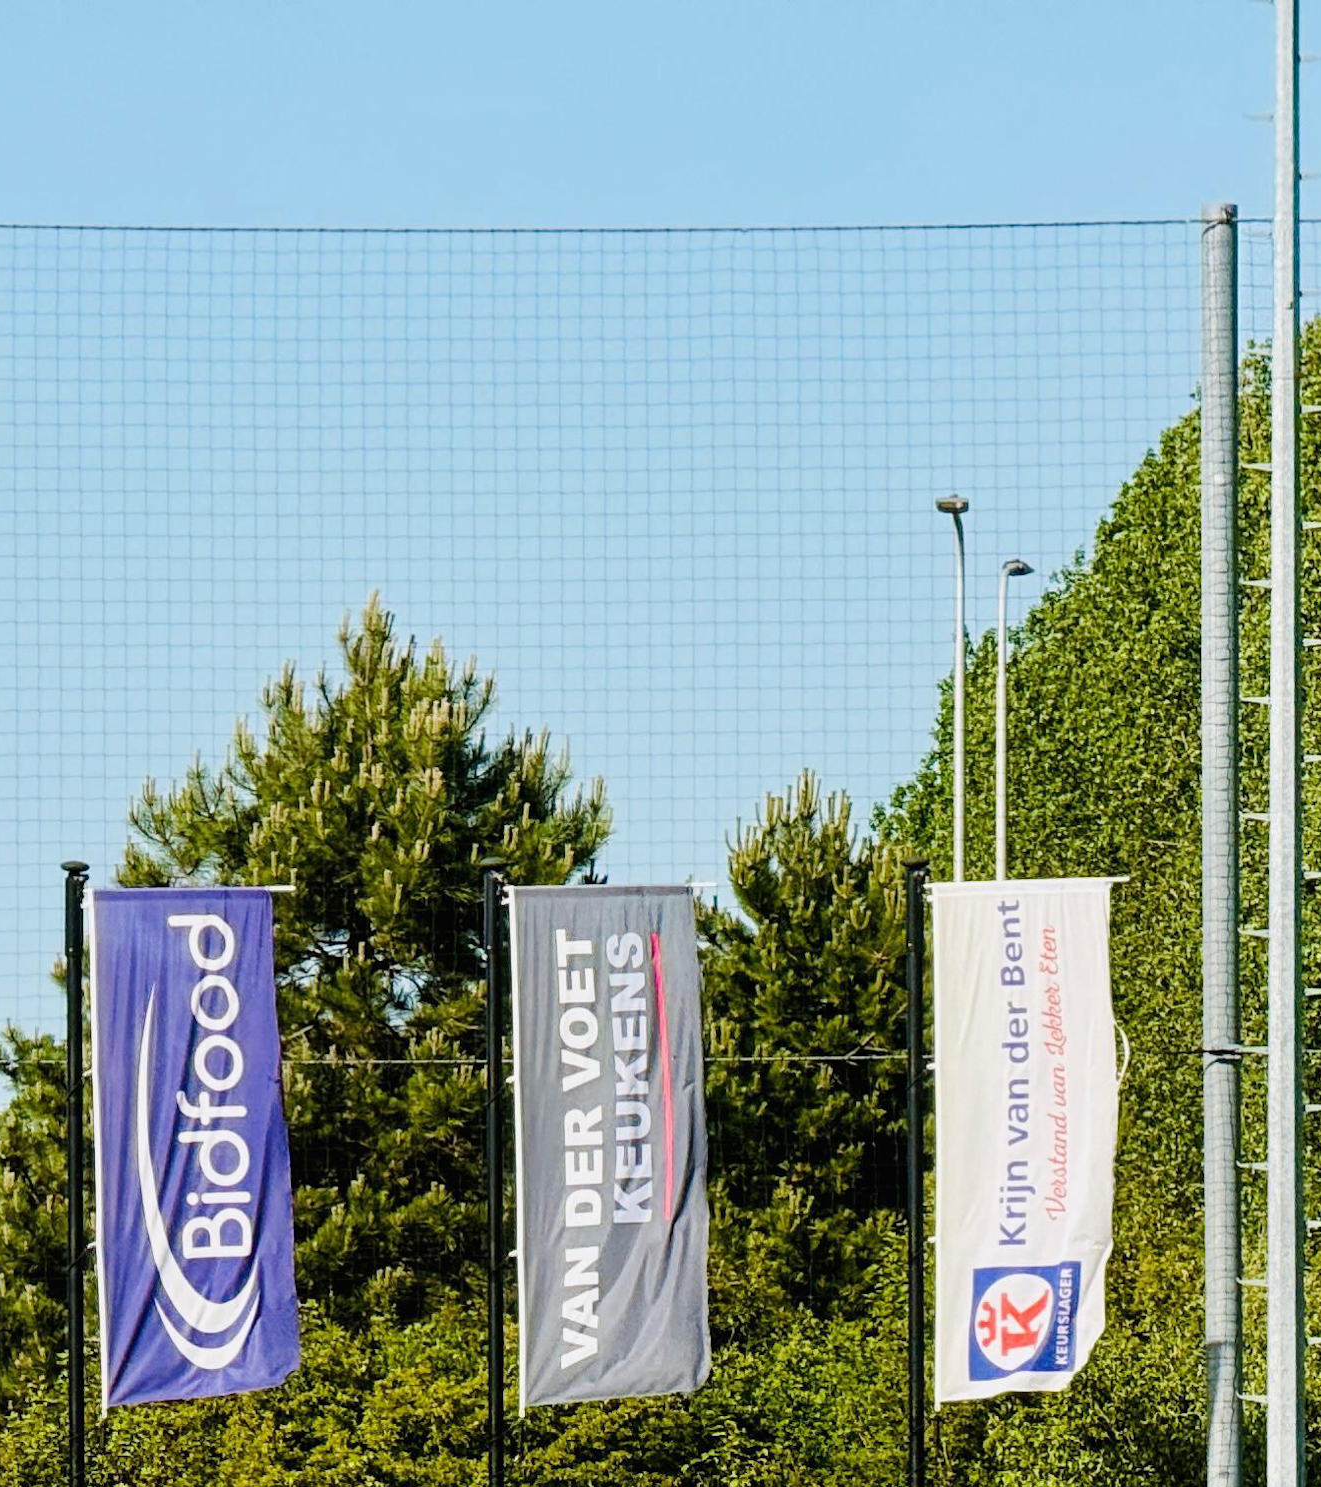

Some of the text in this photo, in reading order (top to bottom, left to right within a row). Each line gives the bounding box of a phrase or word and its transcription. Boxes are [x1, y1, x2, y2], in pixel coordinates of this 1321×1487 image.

[167, 913, 253, 1260] Bidfood
[555, 928, 604, 1370] VAN DER VOET
[606, 931, 653, 1225] KEUKENS
[996, 900, 1036, 1247] Krijn van der Bent
[1039, 924, 1068, 1222] Verstand van Lekker Eten
[1055, 1267, 1074, 1365] KEURSLAGER
